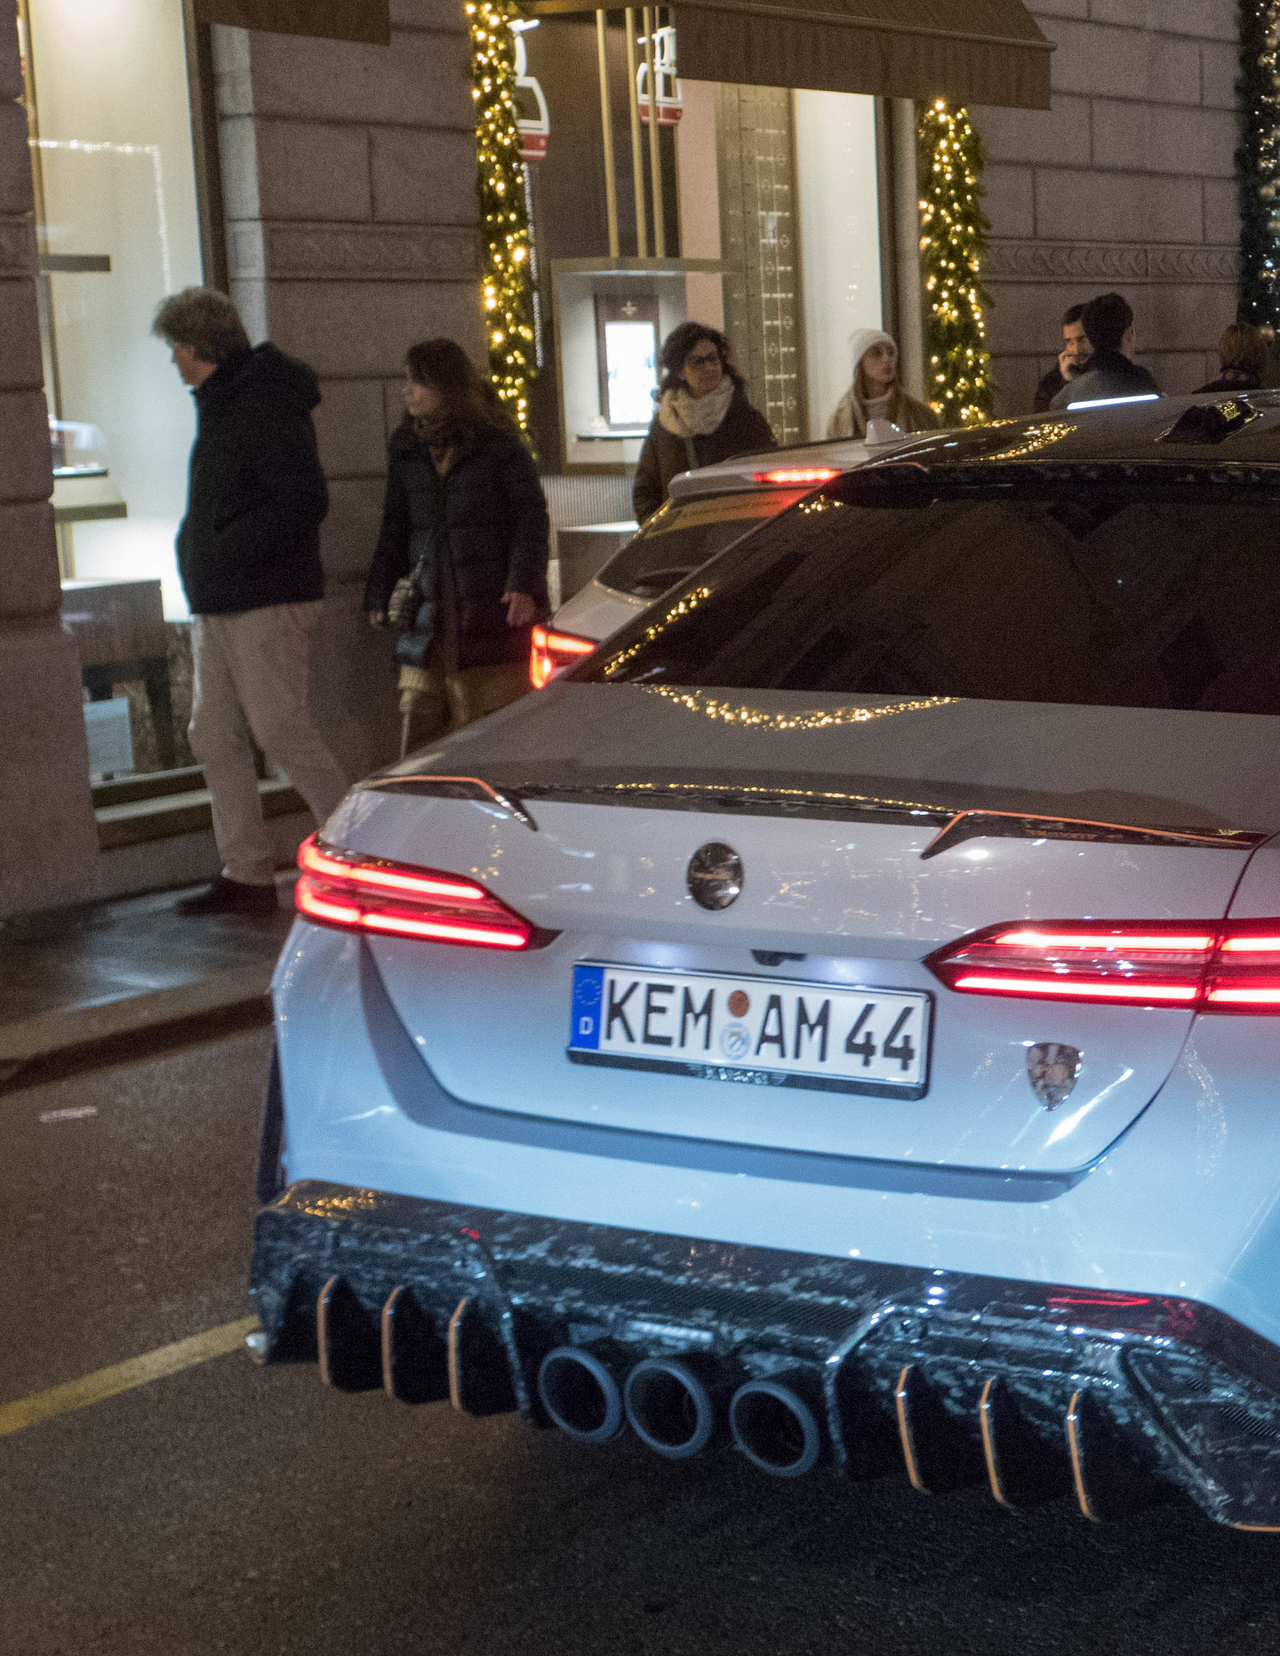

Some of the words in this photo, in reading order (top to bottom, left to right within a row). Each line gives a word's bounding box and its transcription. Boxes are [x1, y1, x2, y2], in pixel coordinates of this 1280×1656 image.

[579, 1016, 594, 1035] D
[605, 978, 715, 1051] KEM
[754, 994, 831, 1062] AM
[844, 1002, 916, 1072] 44
